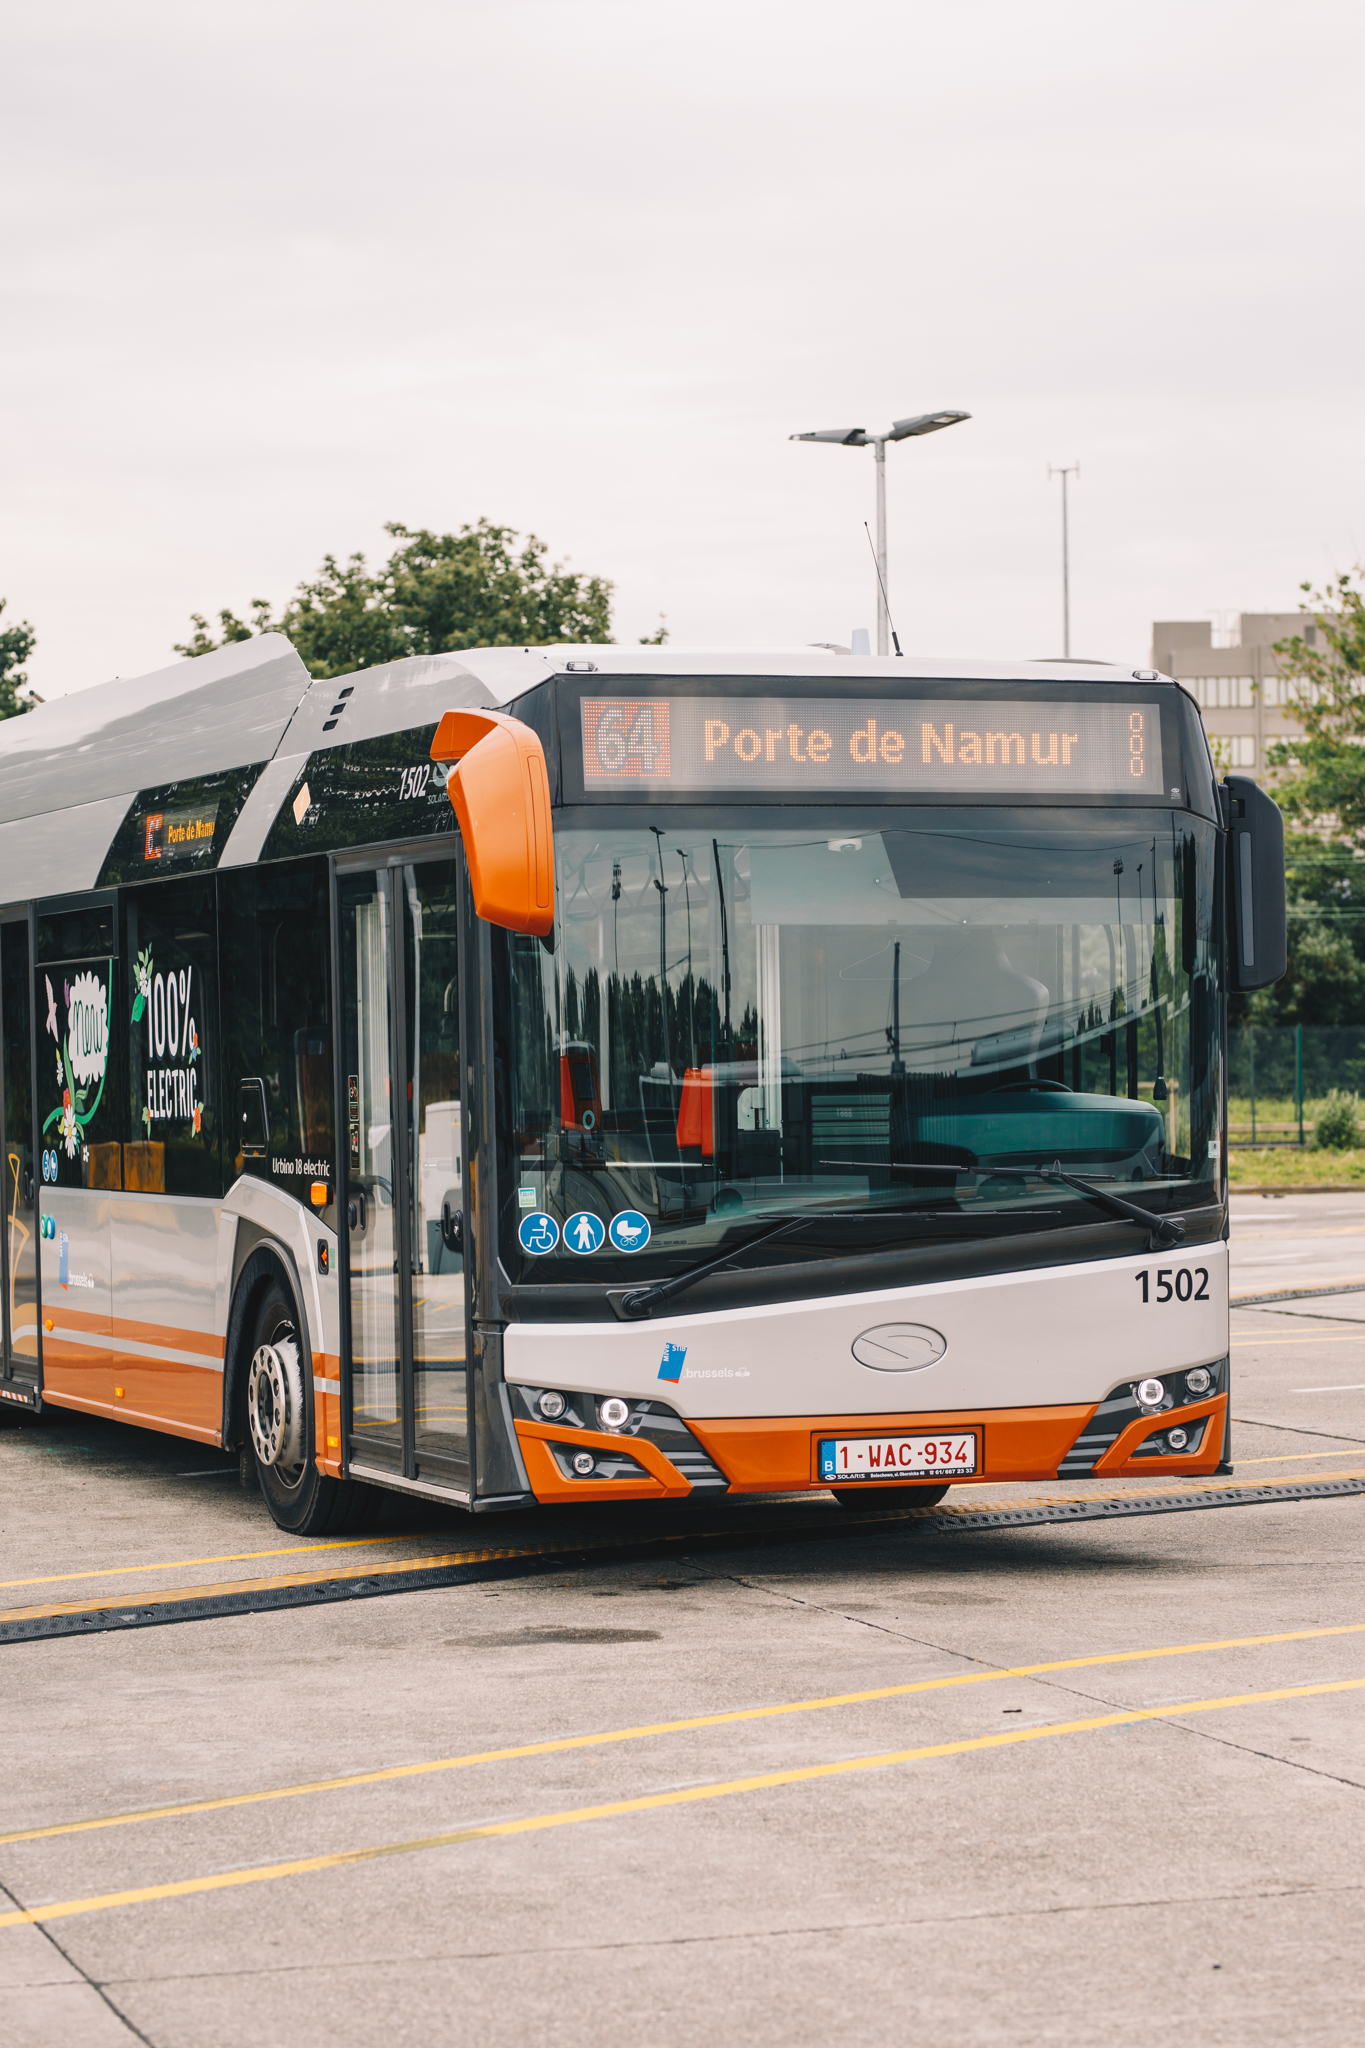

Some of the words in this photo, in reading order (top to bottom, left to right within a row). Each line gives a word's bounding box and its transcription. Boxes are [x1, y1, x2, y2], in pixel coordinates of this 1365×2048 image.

[597, 707, 660, 774] 64
[704, 719, 832, 763] Porte
[850, 719, 905, 764] de
[921, 722, 1079, 767] Namur
[399, 763, 431, 800] 1502
[167, 823, 186, 844] Porte
[186, 819, 196, 841] de
[195, 819, 216, 838] Namu
[147, 965, 197, 1059] 100%
[146, 1067, 198, 1119] ELECTRIC
[272, 1157, 295, 1174] Urbino
[295, 1158, 303, 1175] 18
[303, 1158, 331, 1177] electric
[1134, 1267, 1210, 1304] 1502
[824, 1460, 834, 1472] B
